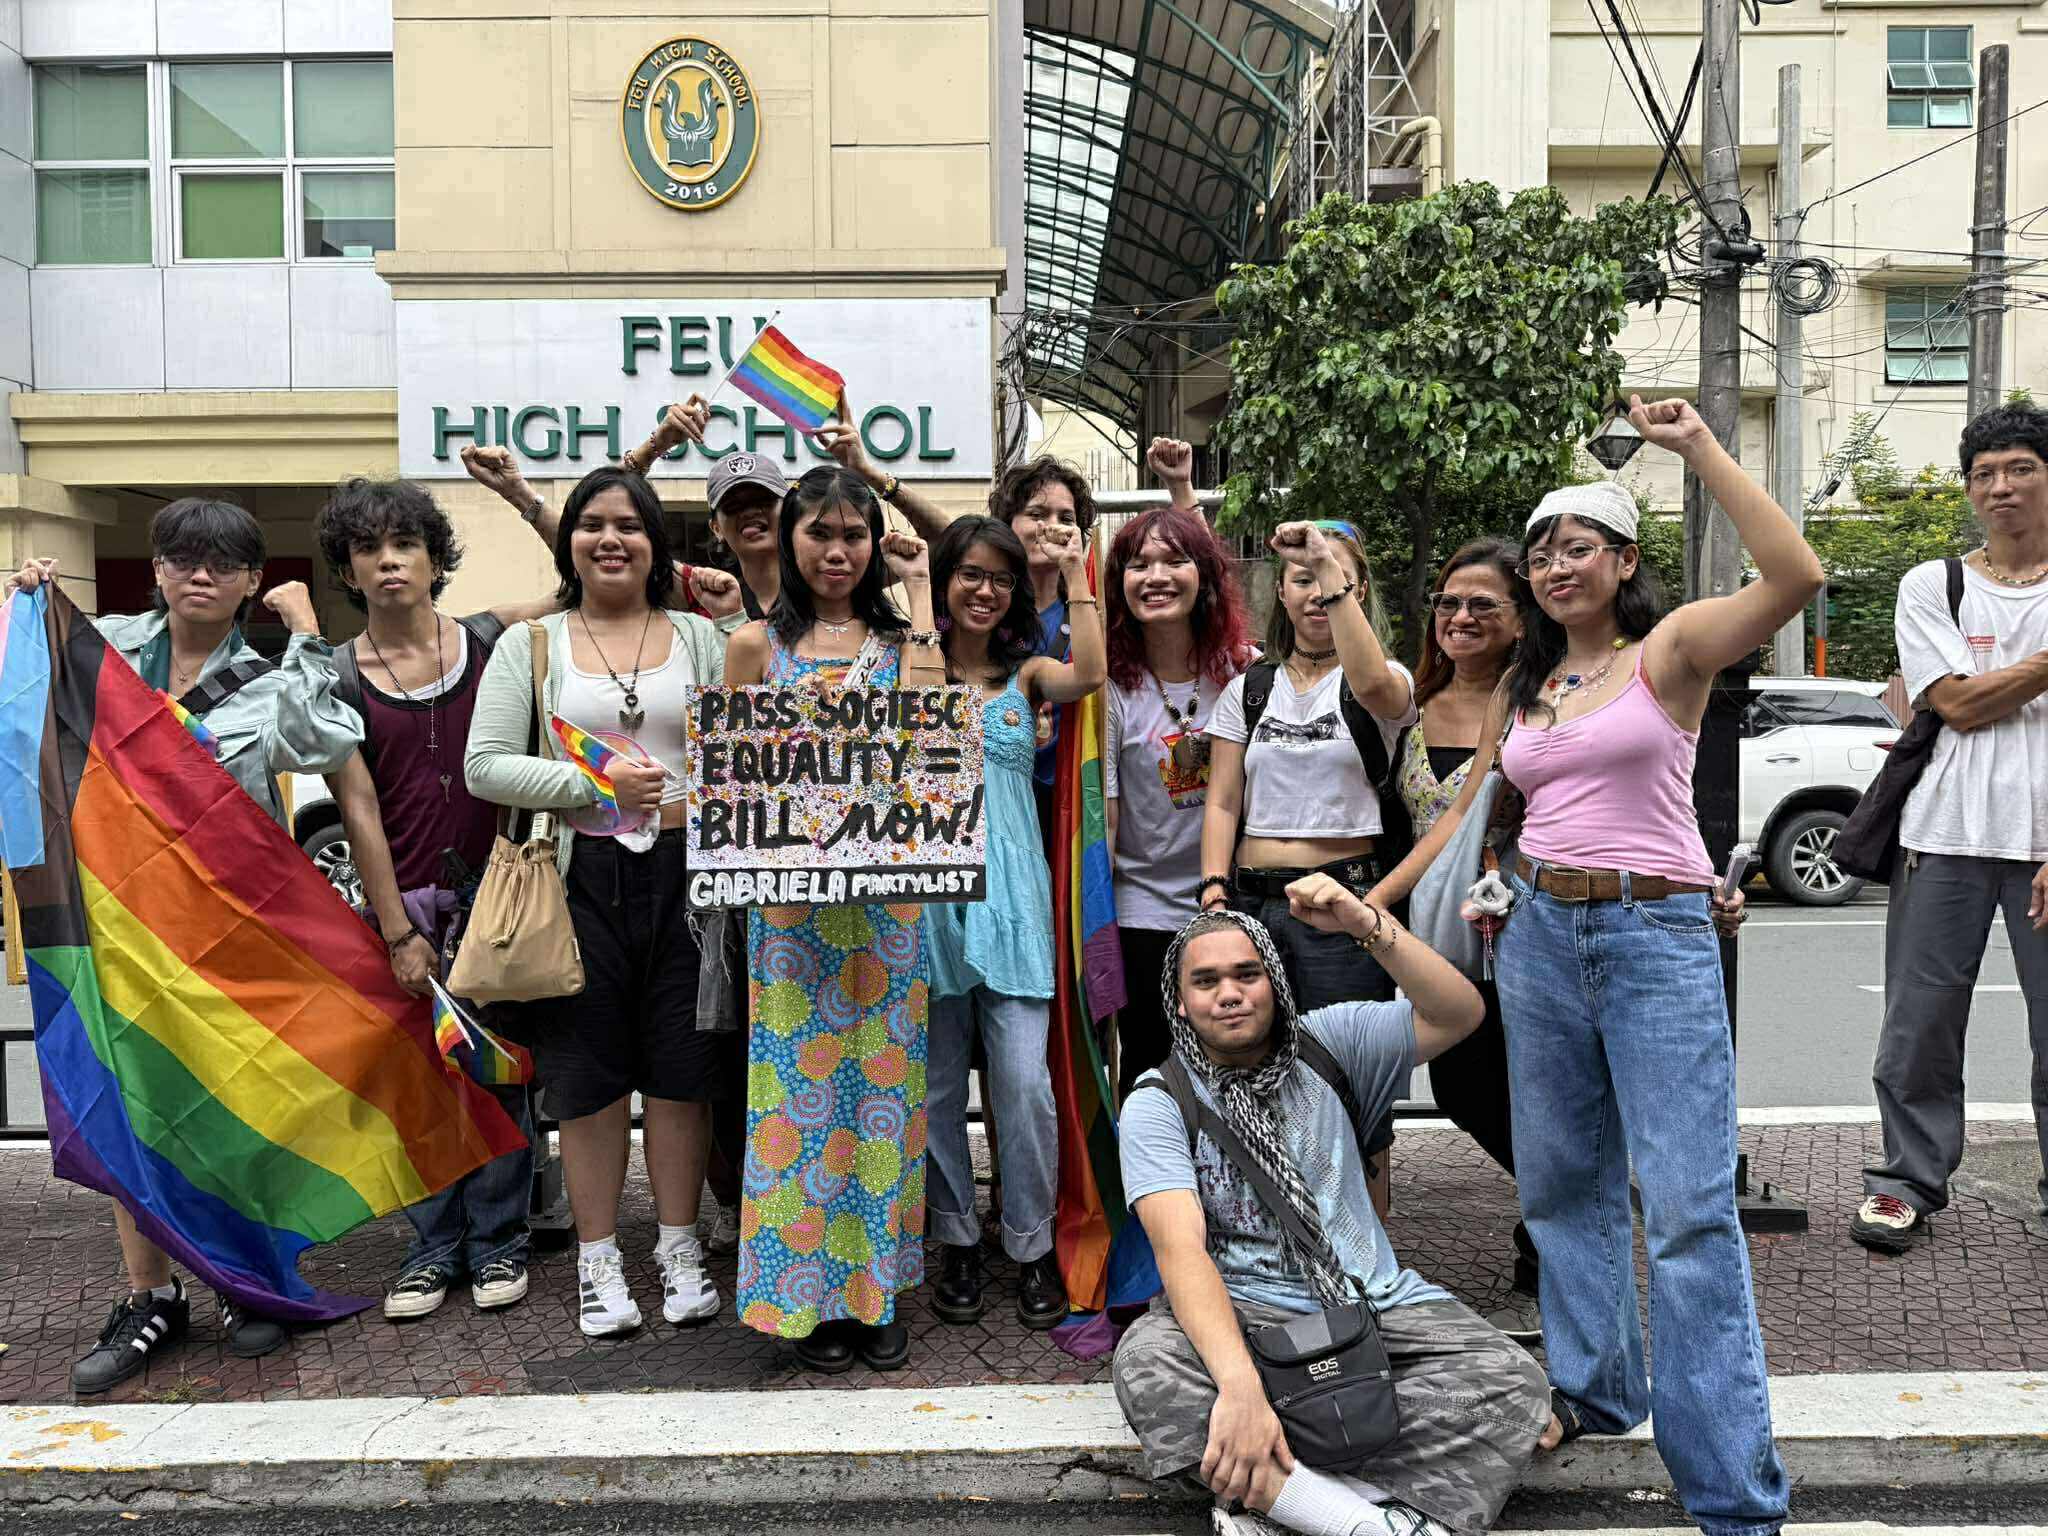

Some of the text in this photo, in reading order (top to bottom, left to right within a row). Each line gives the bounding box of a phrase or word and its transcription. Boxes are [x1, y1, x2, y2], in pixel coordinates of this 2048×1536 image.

[627, 75, 650, 110] FEU
[703, 47, 751, 110] SCHOOL
[665, 182, 718, 199] 2016
[432, 405, 621, 460] HIGH
[700, 690, 965, 733] PASS SOGIESC
[702, 741, 912, 785] EQUALITY
[700, 800, 812, 850] BILL
[690, 870, 978, 906] GABRIELA PARTYLIST
[1308, 1357, 1338, 1374] EOS
[1312, 1369, 1342, 1381] DIGITAL
